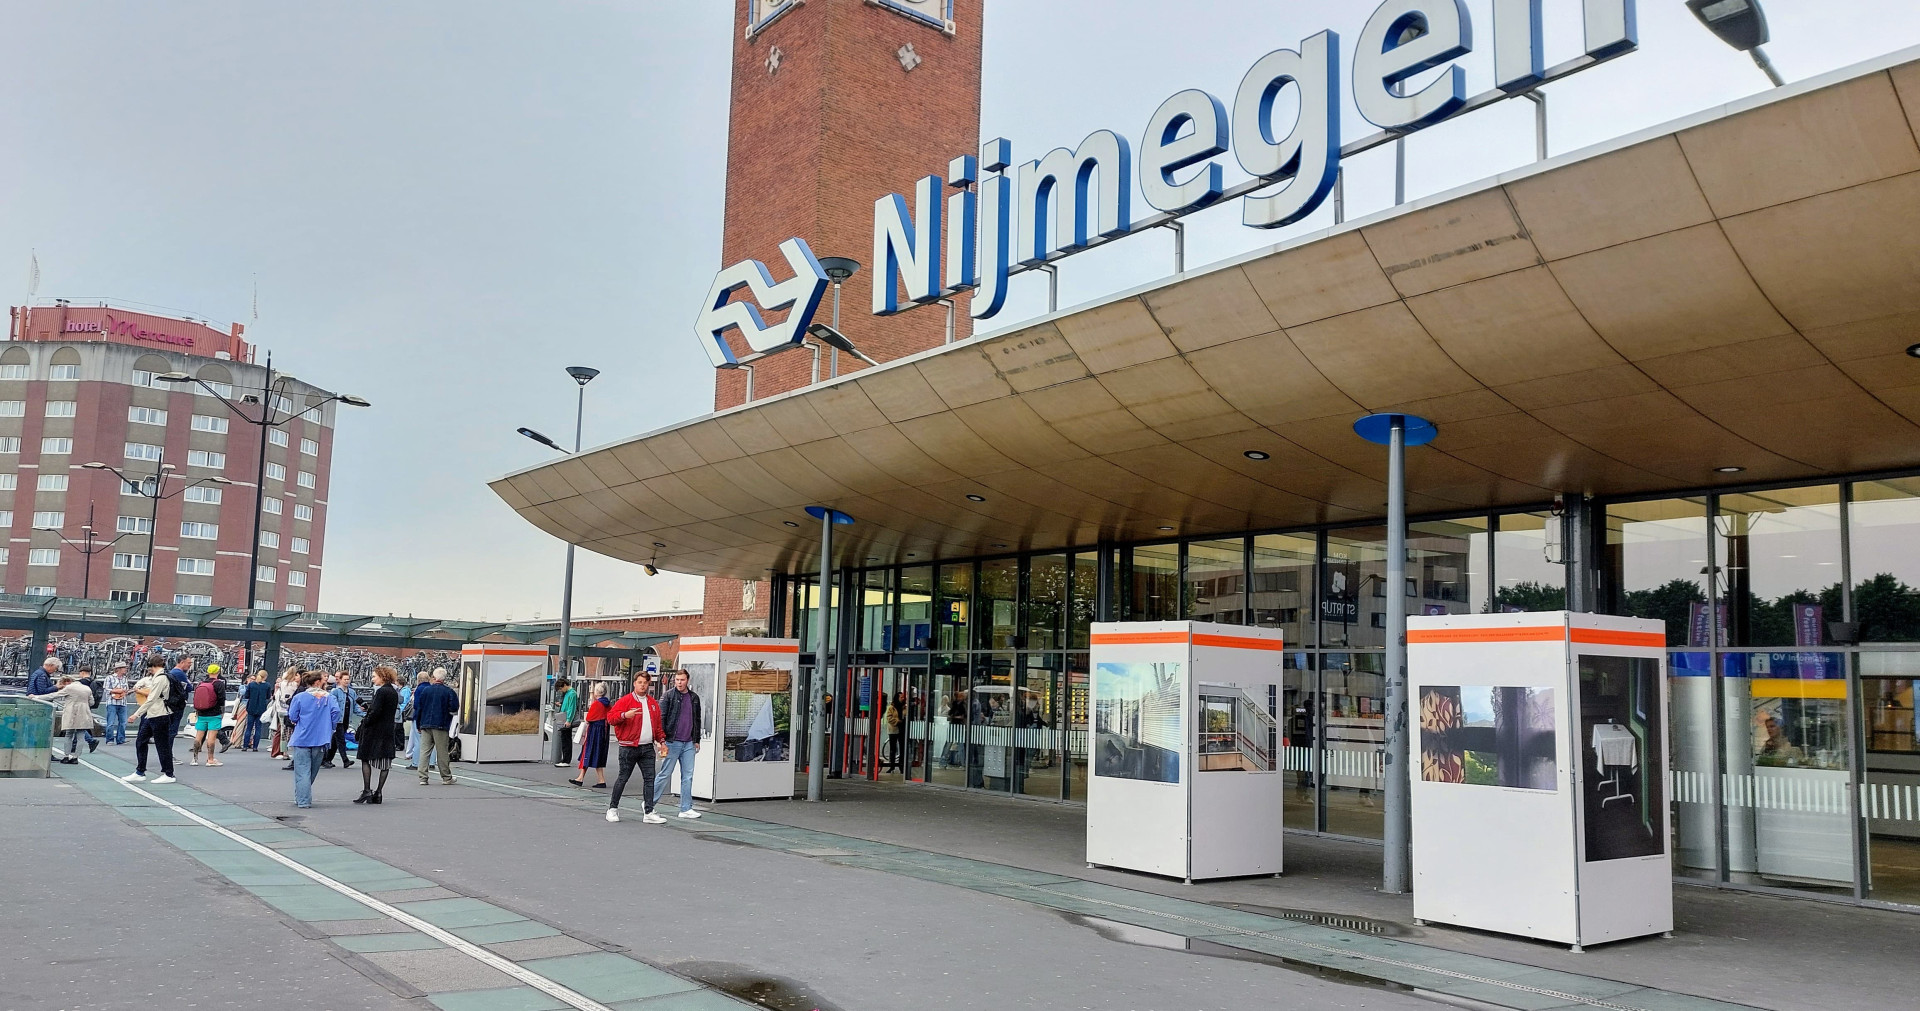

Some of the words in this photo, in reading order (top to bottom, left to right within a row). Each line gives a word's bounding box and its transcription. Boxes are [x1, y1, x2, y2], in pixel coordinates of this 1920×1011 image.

[65, 320, 103, 332] hotel
[107, 314, 194, 347] Mercure
[1772, 653, 1785, 661] OV
